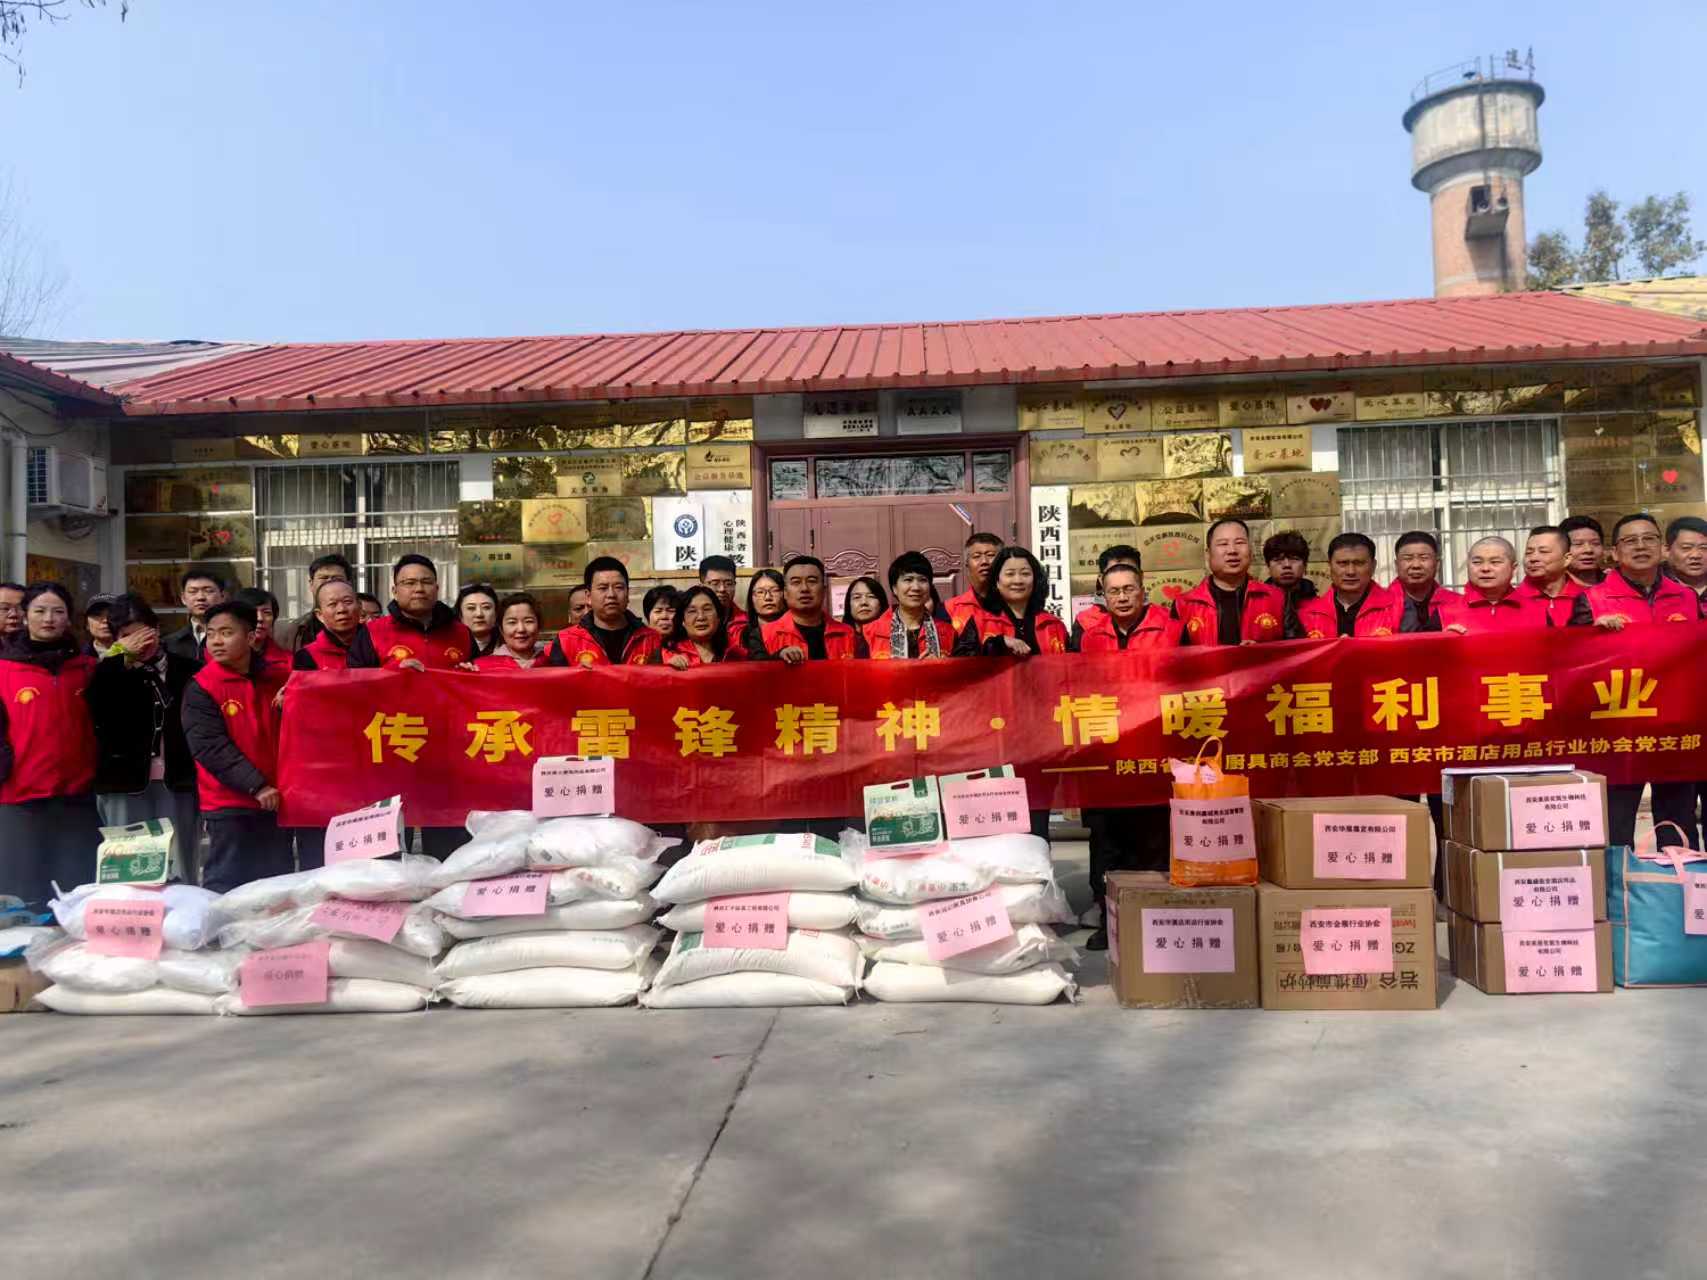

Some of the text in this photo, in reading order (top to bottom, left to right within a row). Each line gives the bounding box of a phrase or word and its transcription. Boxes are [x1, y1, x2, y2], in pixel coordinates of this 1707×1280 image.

[1390, 734, 1701, 764] 西安市酒店用品行业协会党支部
[544, 784, 604, 798] 爱心捐赠
[1525, 820, 1591, 835] 爱心捐赠
[1183, 833, 1244, 848] 爱心捐赠
[1327, 851, 1393, 864] 爱心捐赠
[1513, 895, 1579, 908] 爱心捐赠
[715, 921, 775, 934] 爱心捐赠
[937, 914, 997, 944] 爱心捐赠
[1156, 937, 1221, 949] 爱心捐赠
[1312, 939, 1379, 952] 爱心捐赠
[1518, 966, 1583, 978] 爱心捐赠
[1379, 970, 1419, 990] 岩谷
